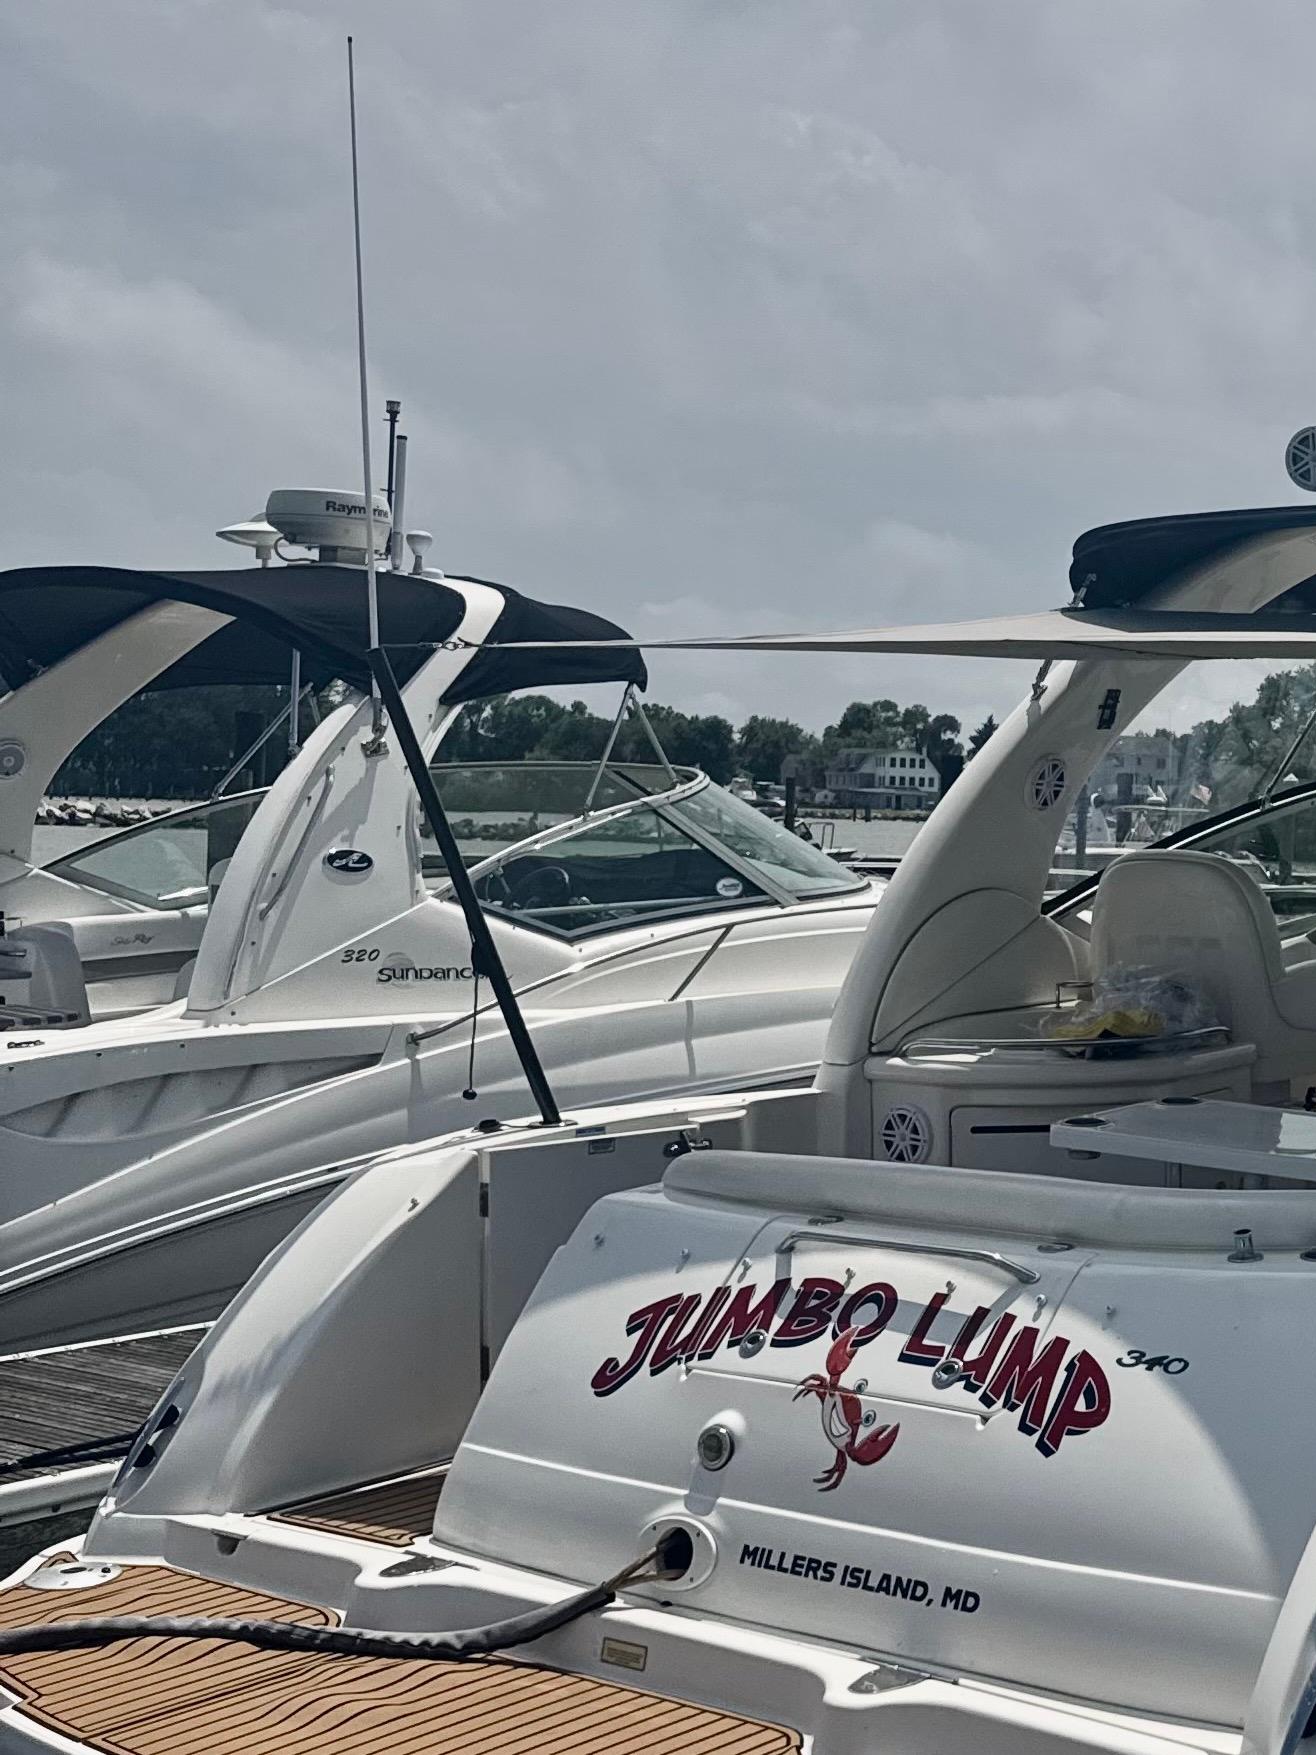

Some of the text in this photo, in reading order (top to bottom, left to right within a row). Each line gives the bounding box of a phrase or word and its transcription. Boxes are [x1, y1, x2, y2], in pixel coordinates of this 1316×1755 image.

[325, 500, 390, 519] Raymrine
[341, 948, 380, 964] 320
[591, 1277, 1112, 1458] JUMBO LUMP
[1116, 1349, 1190, 1375] 340
[739, 1543, 981, 1614] MILLERS ISLAND, MD
